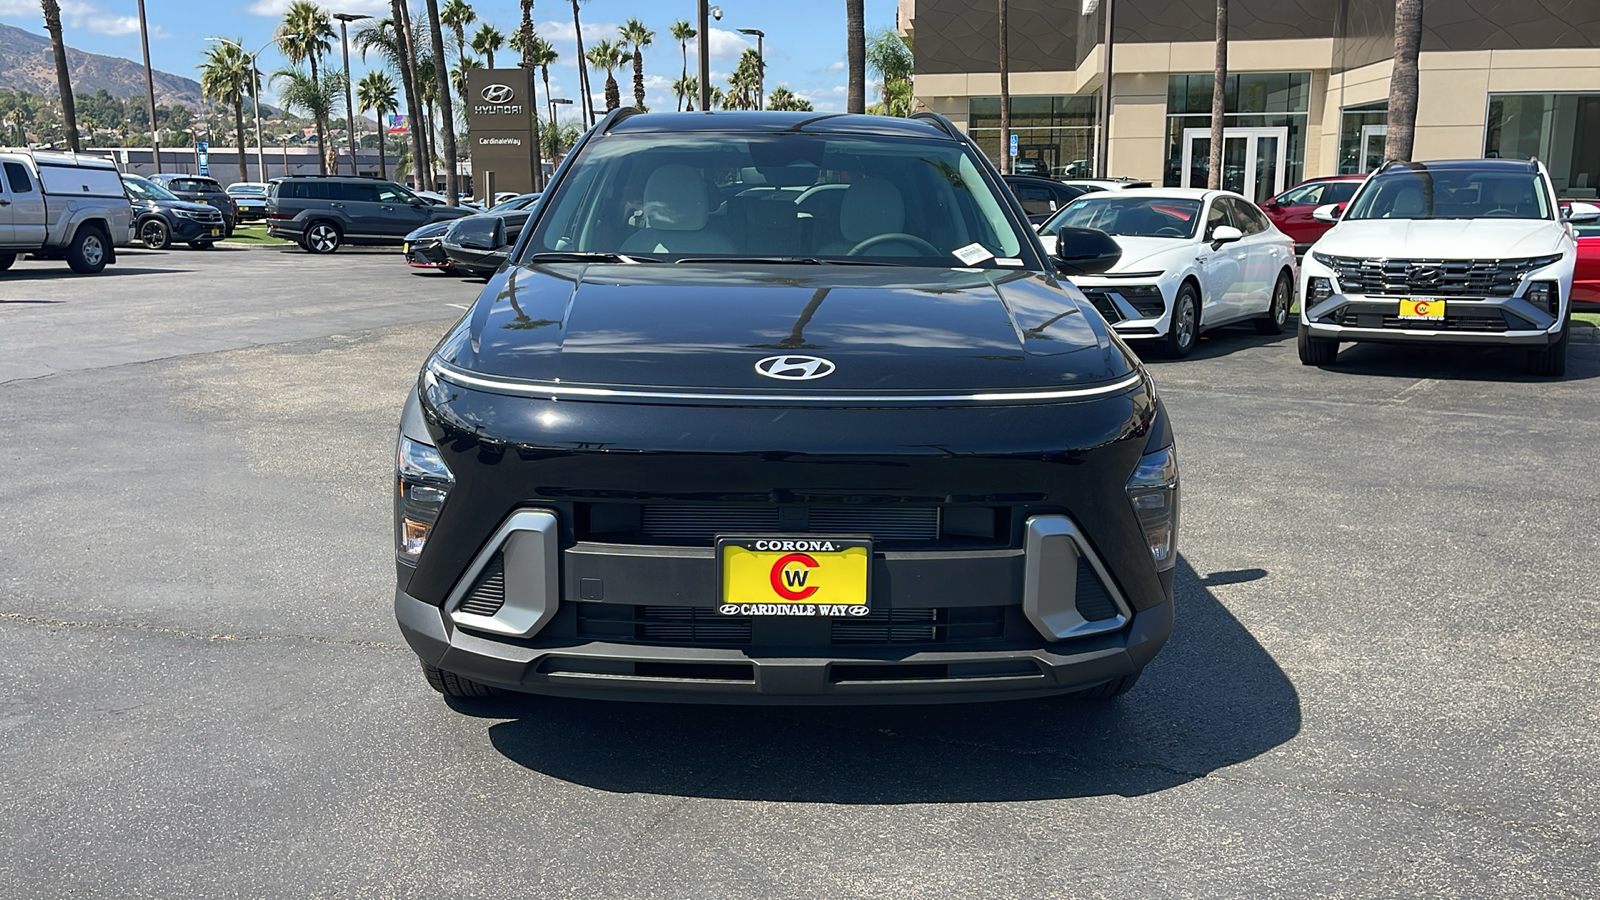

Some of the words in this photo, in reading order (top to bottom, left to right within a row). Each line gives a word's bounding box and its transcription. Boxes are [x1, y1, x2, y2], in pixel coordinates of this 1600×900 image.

[474, 105, 522, 114] HYUNDAI
[479, 137, 521, 146] CardinaleWay
[755, 540, 835, 551] CORONA
[741, 604, 816, 616] CARDINALE
[819, 604, 849, 616] WAY
